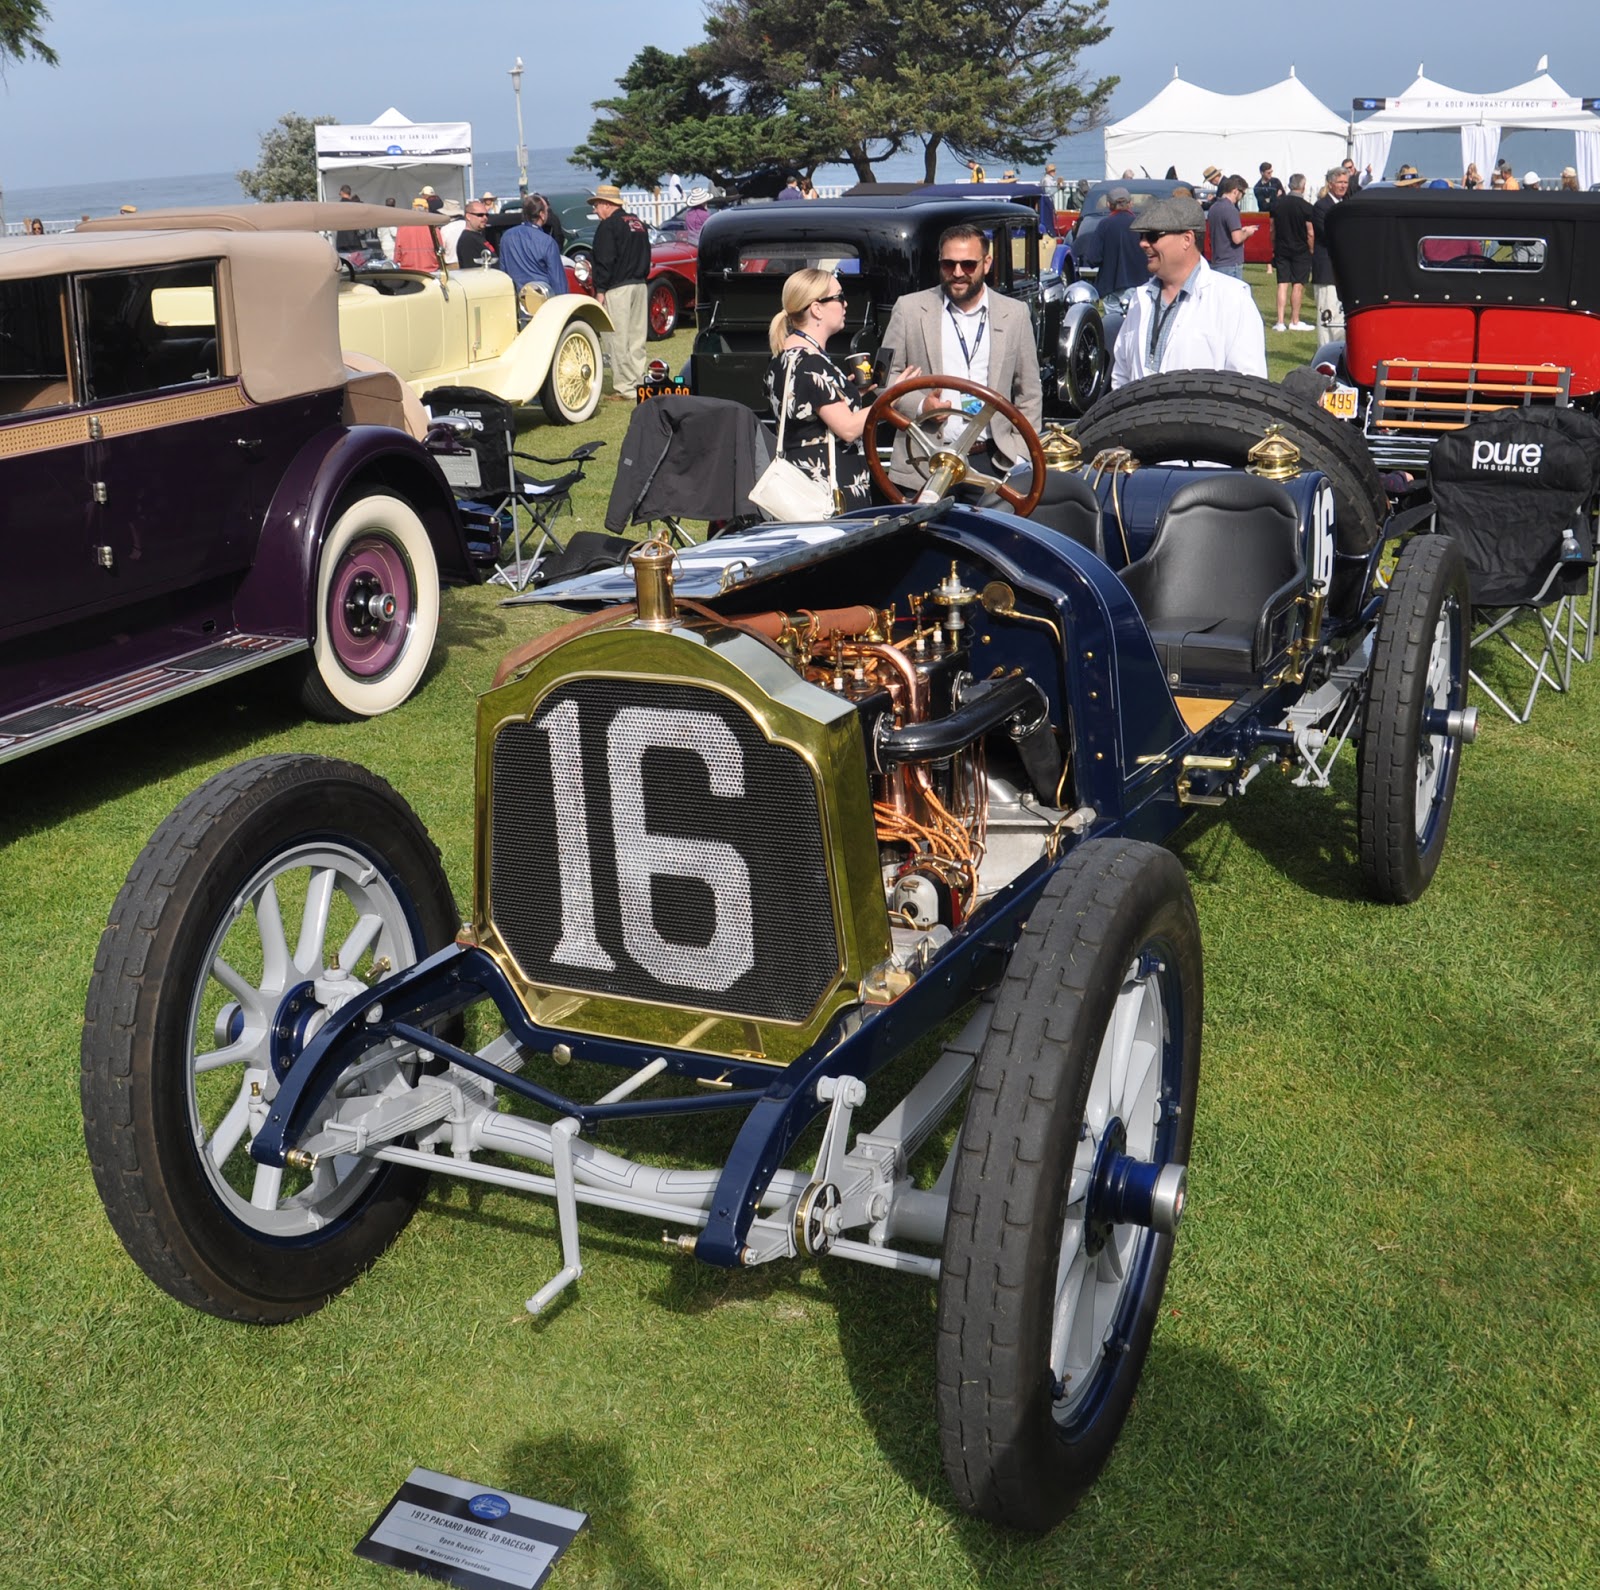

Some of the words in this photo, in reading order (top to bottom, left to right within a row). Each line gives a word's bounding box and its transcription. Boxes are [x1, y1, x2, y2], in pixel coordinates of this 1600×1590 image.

[1472, 440, 1542, 469] pure
[1479, 464, 1539, 474] INSURANCE
[1312, 486, 1334, 596] 16
[536, 699, 754, 991] 16
[410, 1510, 430, 1521] 1912
[429, 1516, 464, 1531] PACKARD
[463, 1526, 489, 1540] MODEL
[489, 1534, 501, 1543] 30
[500, 1537, 536, 1553] RACECAR
[439, 1537, 455, 1547] Open
[456, 1542, 485, 1555] Roadster
[429, 1548, 461, 1564] Motorsports
[460, 1559, 491, 1572] Foundation
